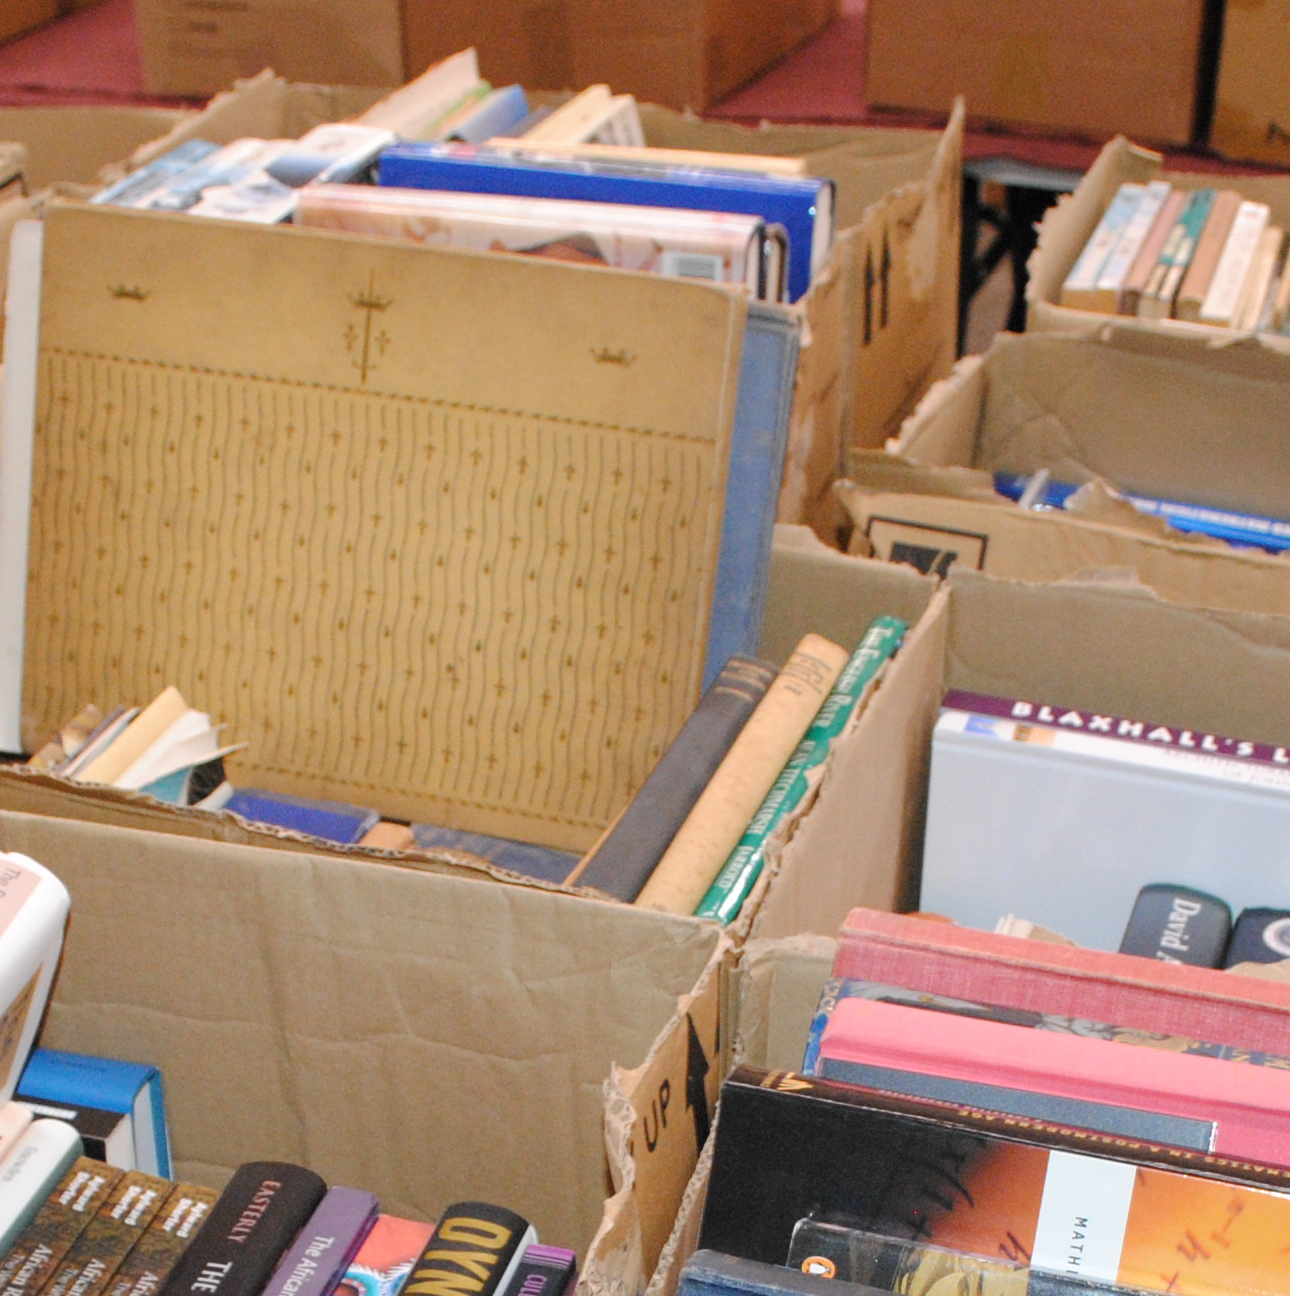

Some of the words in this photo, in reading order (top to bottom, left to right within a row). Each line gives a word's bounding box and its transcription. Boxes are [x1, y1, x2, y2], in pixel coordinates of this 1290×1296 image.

[1010, 700, 1255, 755] BLAXHALL'S
[3, 866, 22, 889] The
[1160, 897, 1202, 953] David
[643, 1077, 671, 1154] UP
[958, 1109, 997, 1122] AGE
[1004, 1117, 1141, 1151] POSTMODERN
[226, 1178, 283, 1245] EASTERLY
[12, 1243, 53, 1287] African
[303, 1235, 336, 1260] The
[191, 1259, 234, 1295] THE
